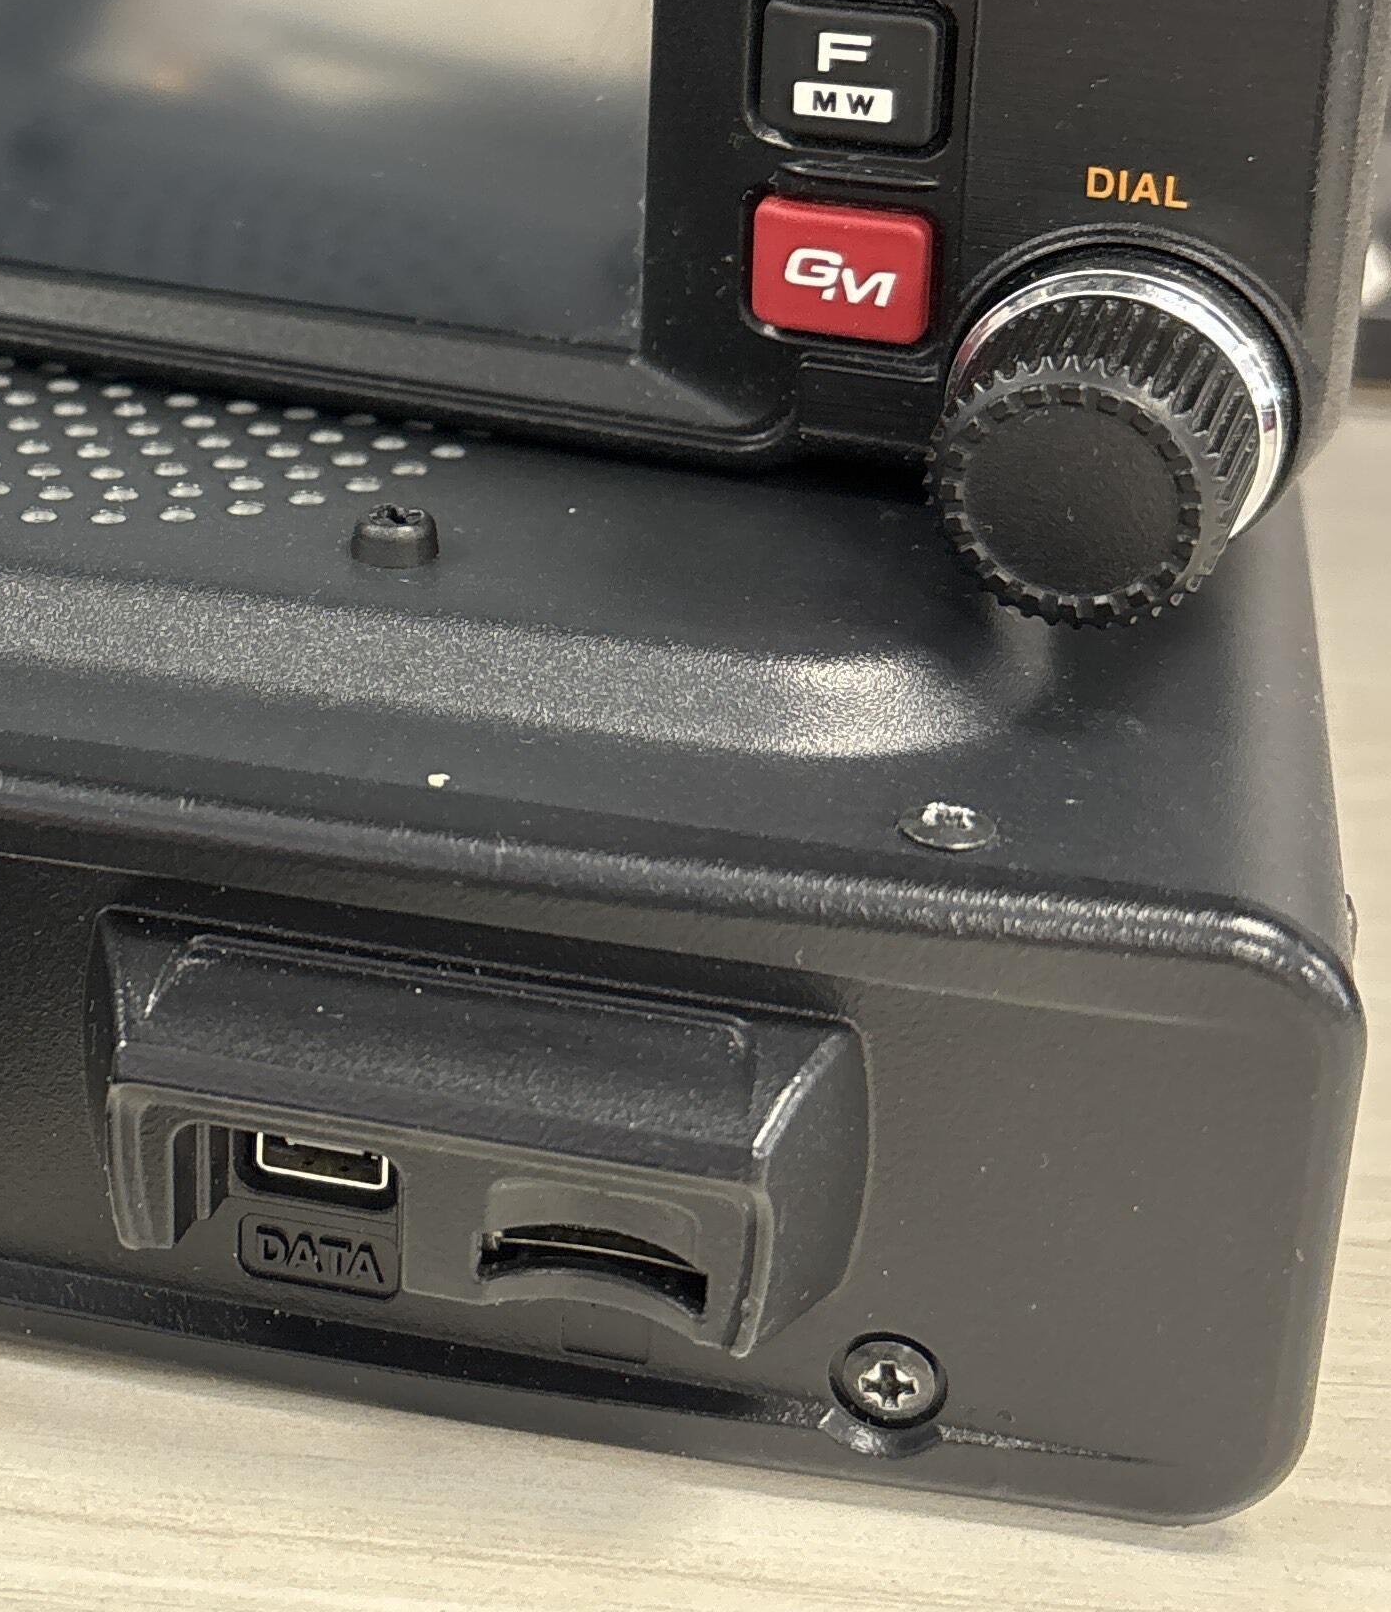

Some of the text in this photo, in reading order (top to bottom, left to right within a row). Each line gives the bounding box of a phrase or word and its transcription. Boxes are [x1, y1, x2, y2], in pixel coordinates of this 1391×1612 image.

[817, 32, 873, 73] F
[1085, 166, 1191, 211] DIAL
[783, 247, 897, 307] GM
[256, 1224, 385, 1284] DATA
